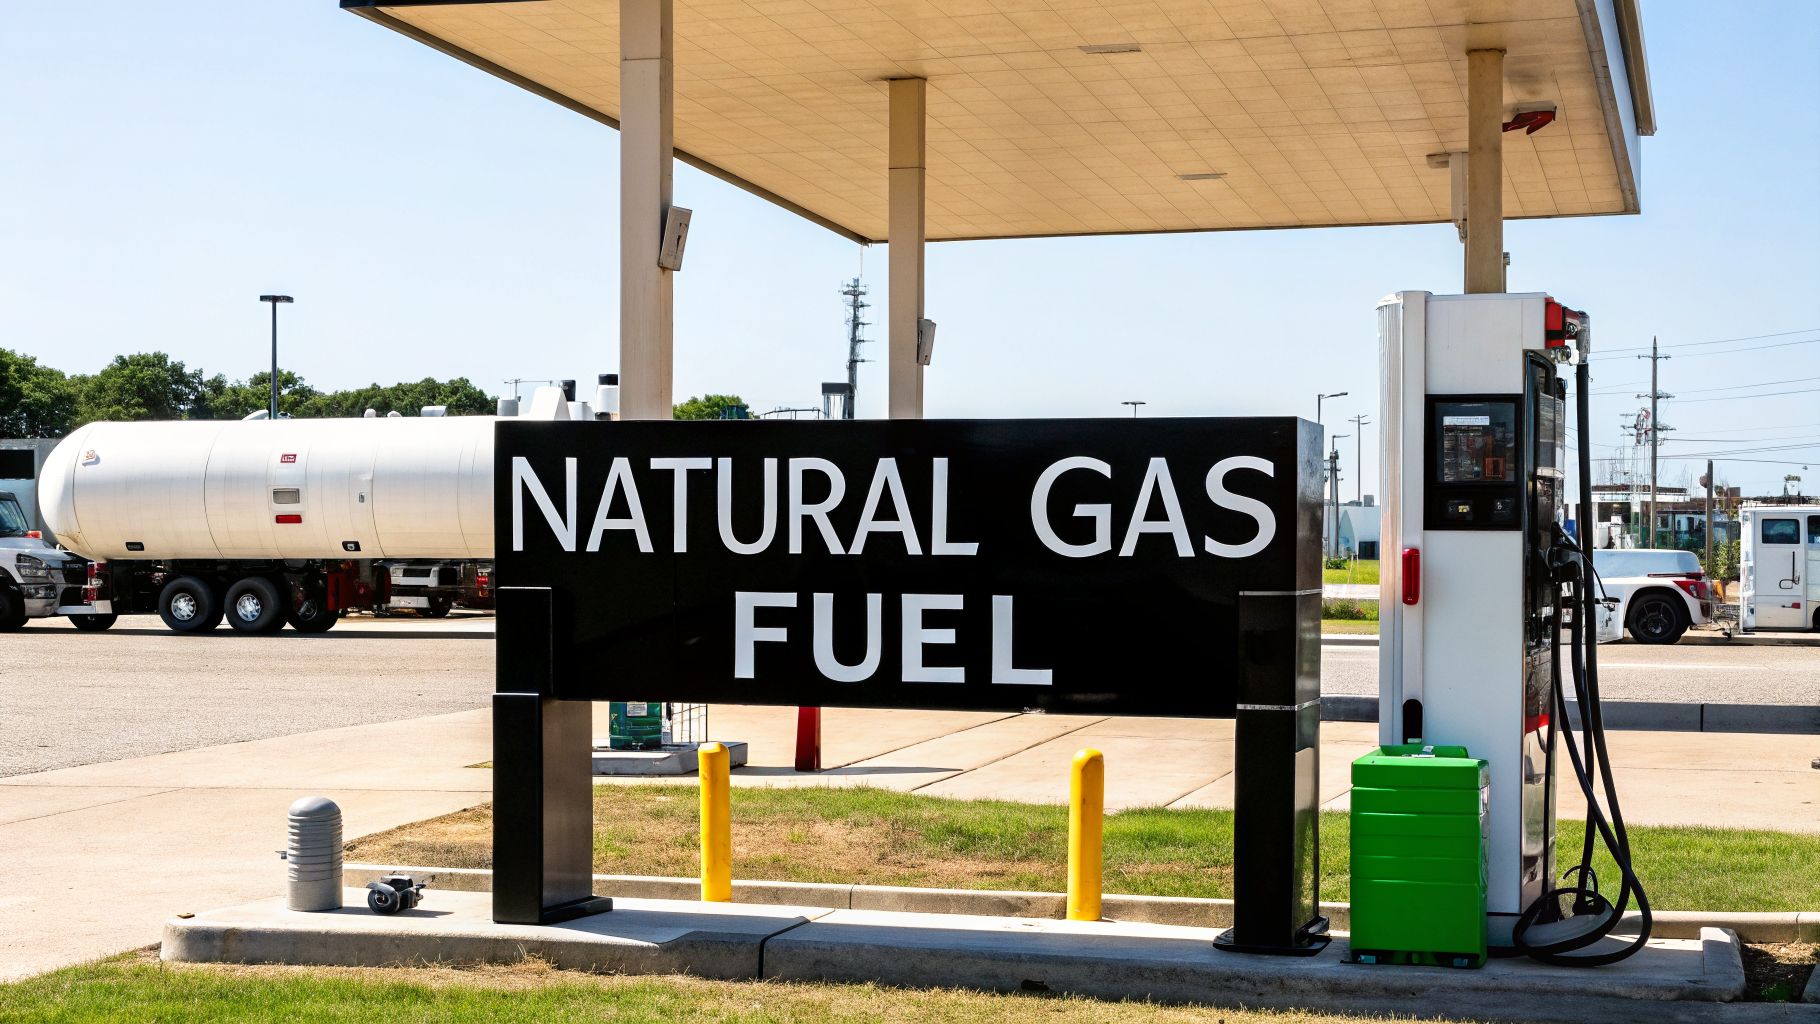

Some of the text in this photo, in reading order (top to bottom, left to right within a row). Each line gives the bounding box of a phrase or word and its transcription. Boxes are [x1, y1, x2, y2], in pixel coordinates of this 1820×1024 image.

[511, 455, 1278, 559] NATURAL GAS
[733, 591, 1054, 687] FUEL
